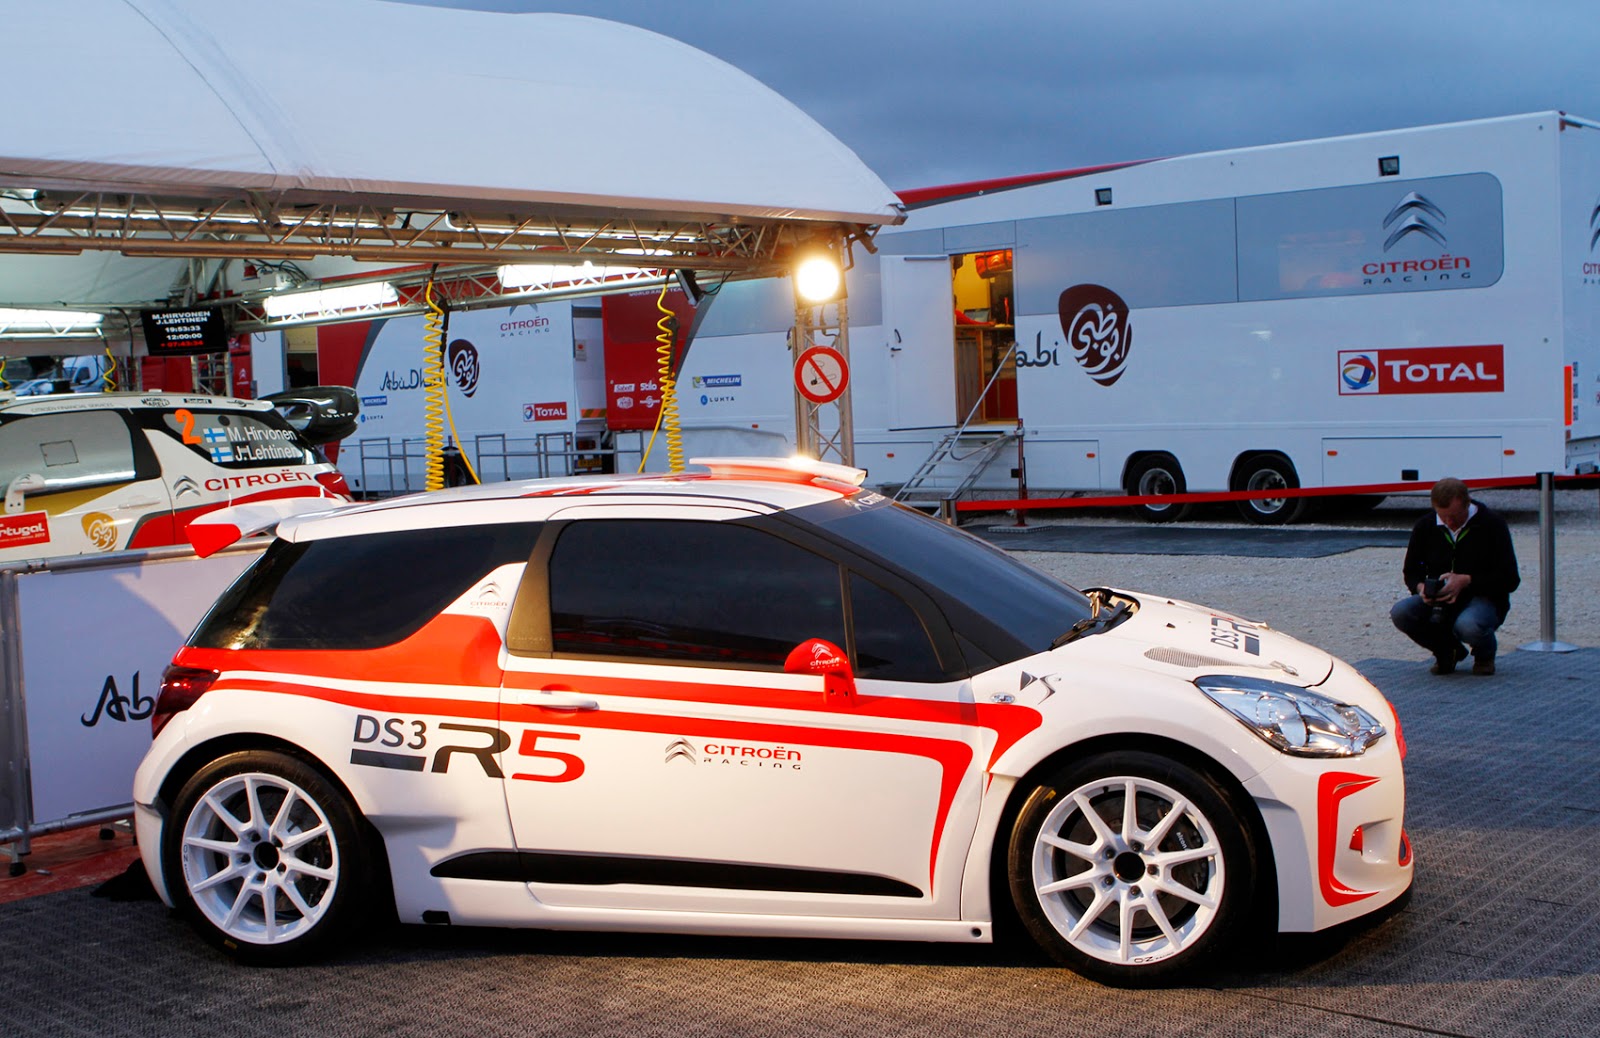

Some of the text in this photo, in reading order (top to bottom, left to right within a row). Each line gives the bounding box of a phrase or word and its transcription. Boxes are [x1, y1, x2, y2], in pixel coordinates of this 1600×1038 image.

[1016, 330, 1060, 368] abi
[706, 377, 741, 385] MICHELIN
[1384, 360, 1498, 383] TOTAL
[536, 406, 566, 417] TOTAL
[174, 408, 202, 445] 2
[0, 522, 45, 538] rtugal
[353, 714, 427, 750] DS3
[703, 757, 801, 770] RACING
